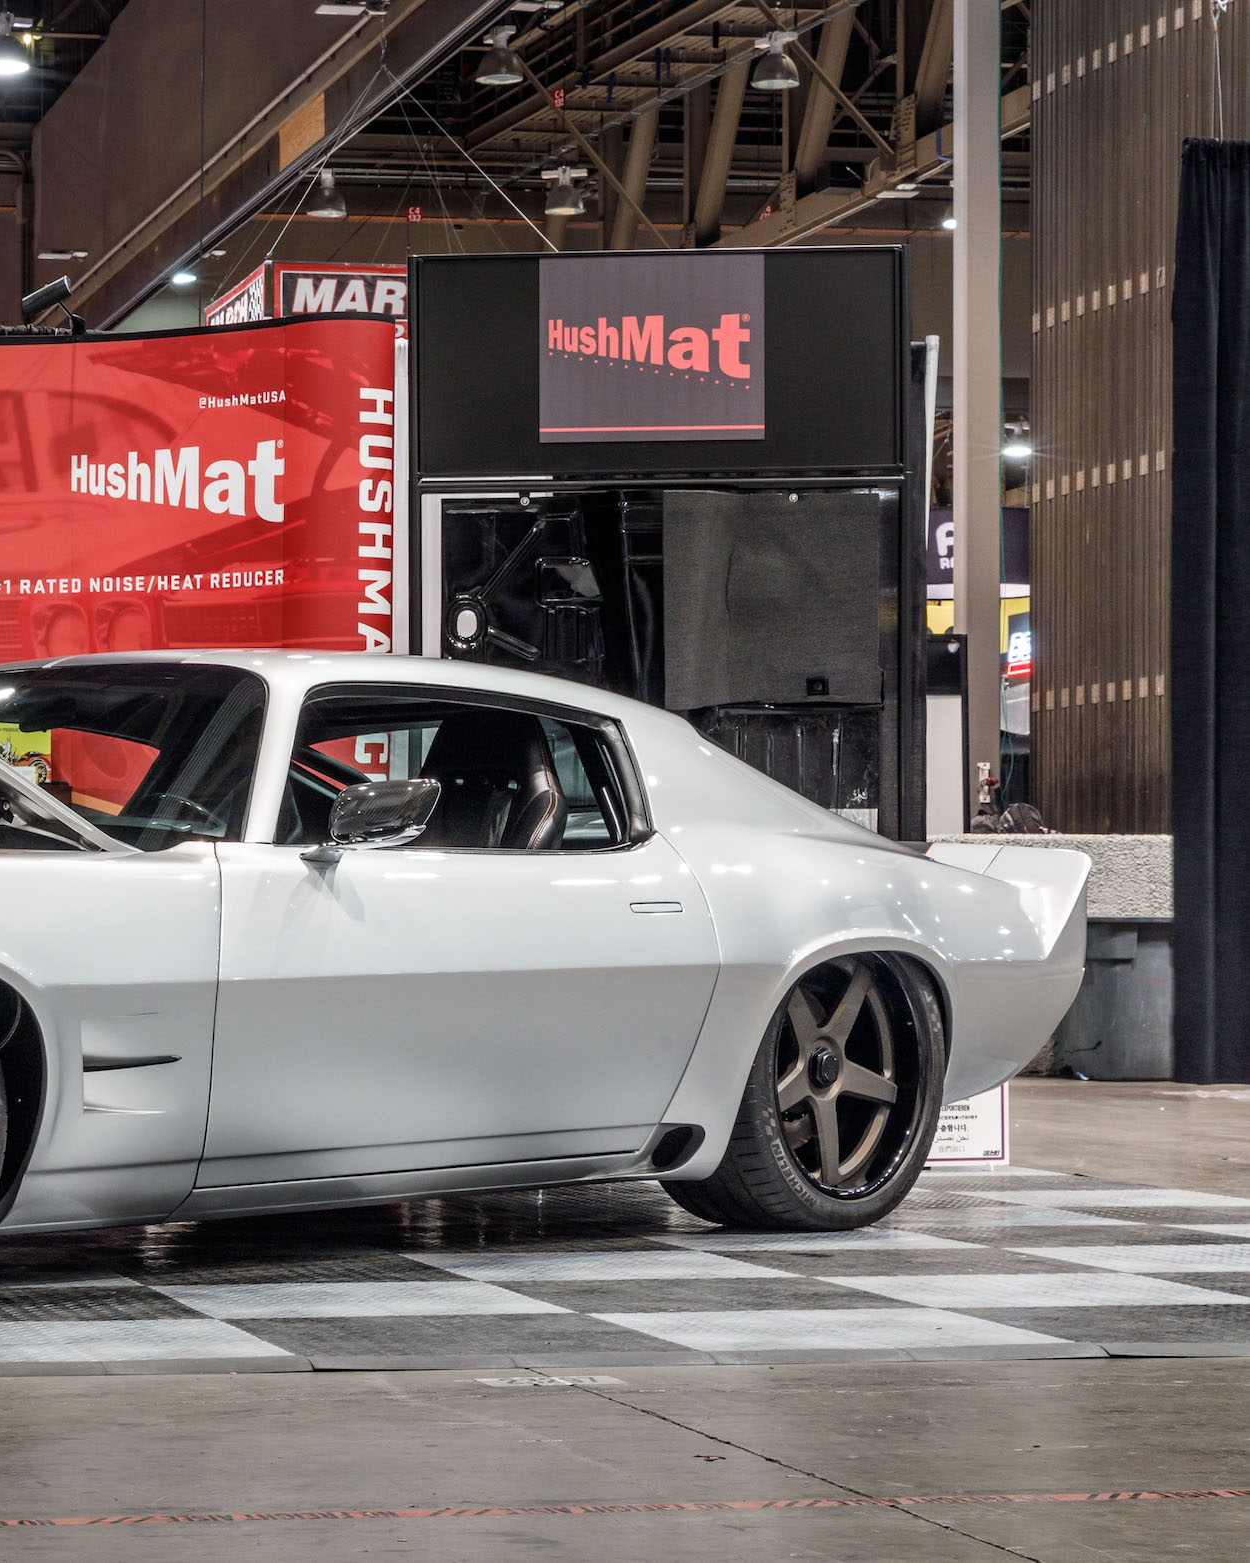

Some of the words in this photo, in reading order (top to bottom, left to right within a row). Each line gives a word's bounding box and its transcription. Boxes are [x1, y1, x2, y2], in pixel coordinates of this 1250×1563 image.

[199, 390, 286, 409] @HushMatUSA
[19, 577, 82, 595] RATED
[89, 573, 204, 594] NOISE/HEAT
[209, 569, 285, 589] REDUCER
[771, 1141, 818, 1208] MICHELIN
[166, 1514, 234, 1523] AISLE
[244, 1511, 353, 1521] FREIGHT
